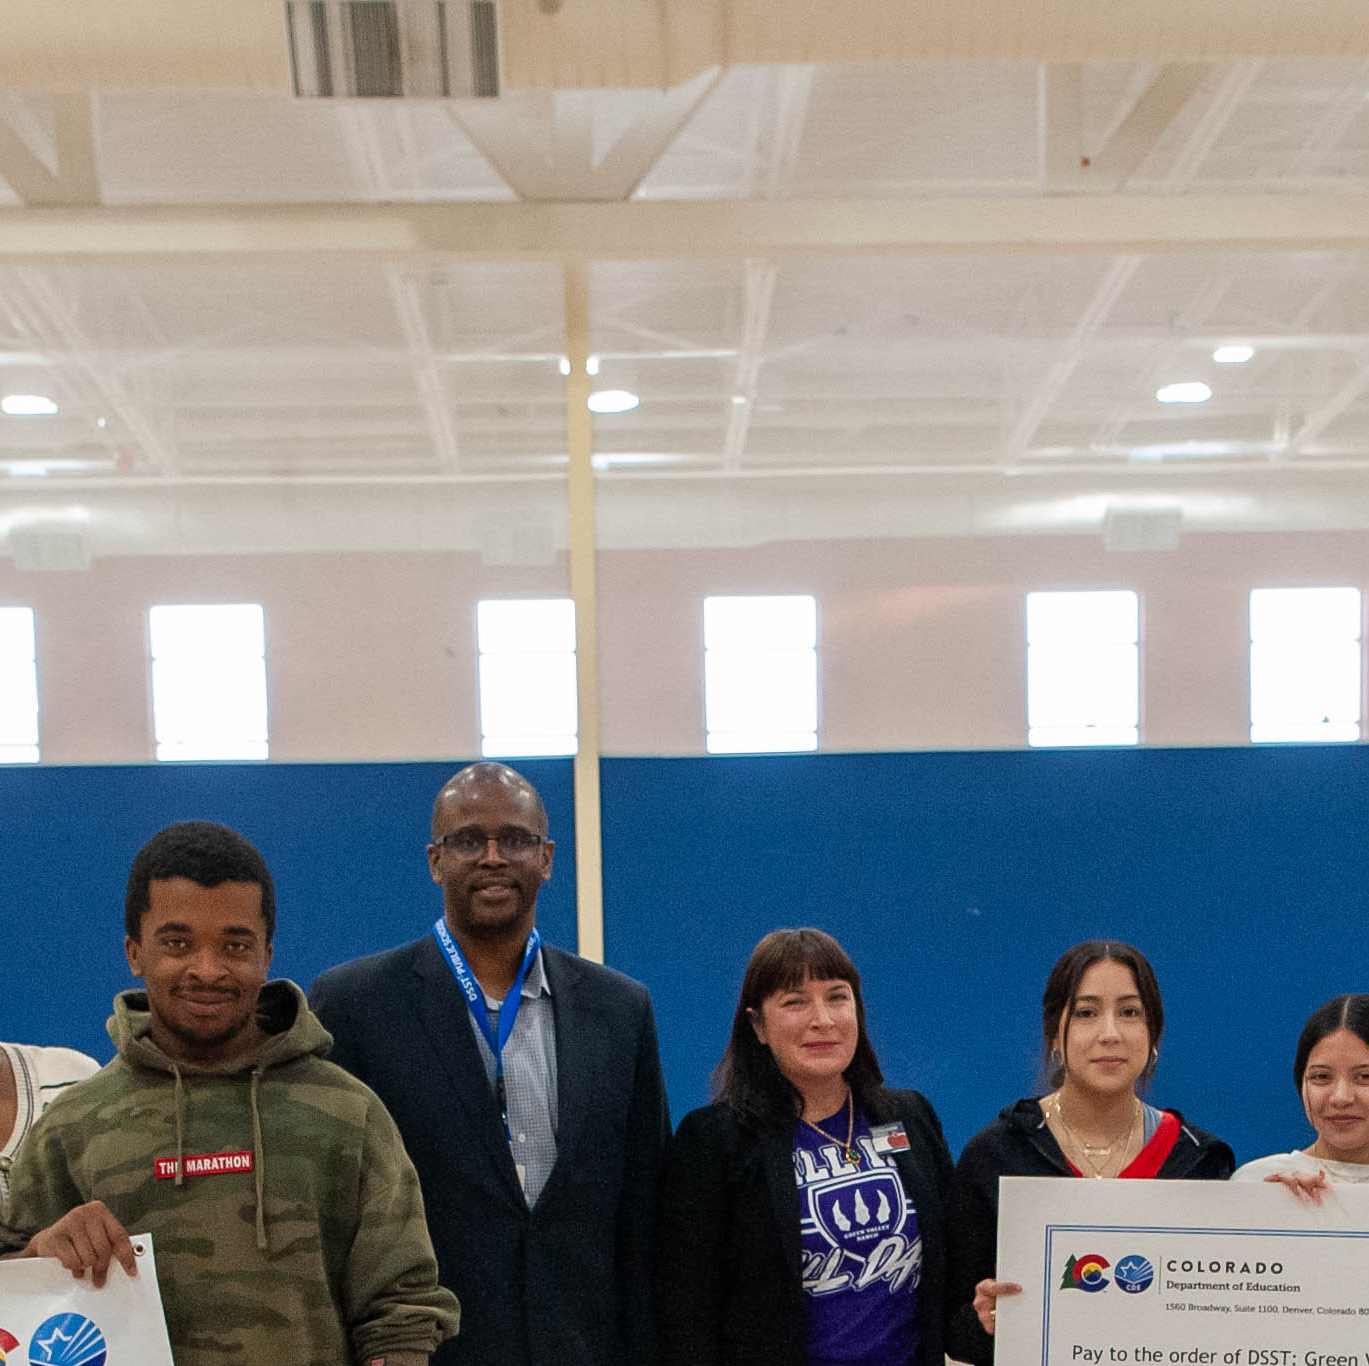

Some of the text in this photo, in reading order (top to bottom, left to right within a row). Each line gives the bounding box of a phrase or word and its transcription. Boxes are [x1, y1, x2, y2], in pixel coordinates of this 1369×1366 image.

[186, 1155, 250, 1173] MARATHON
[1166, 1259, 1284, 1275] COLORADO
[1166, 1280, 1301, 1293] Department of Education
[1234, 1304, 1255, 1313] Suite
[1316, 1306, 1356, 1316] Colorado
[1072, 1345, 1103, 1365] Pay
[1110, 1347, 1127, 1362] to
[1135, 1347, 1163, 1363] the
[1169, 1348, 1218, 1365] order
[1223, 1348, 1242, 1365] of
[1248, 1349, 1297, 1366] DSST:
